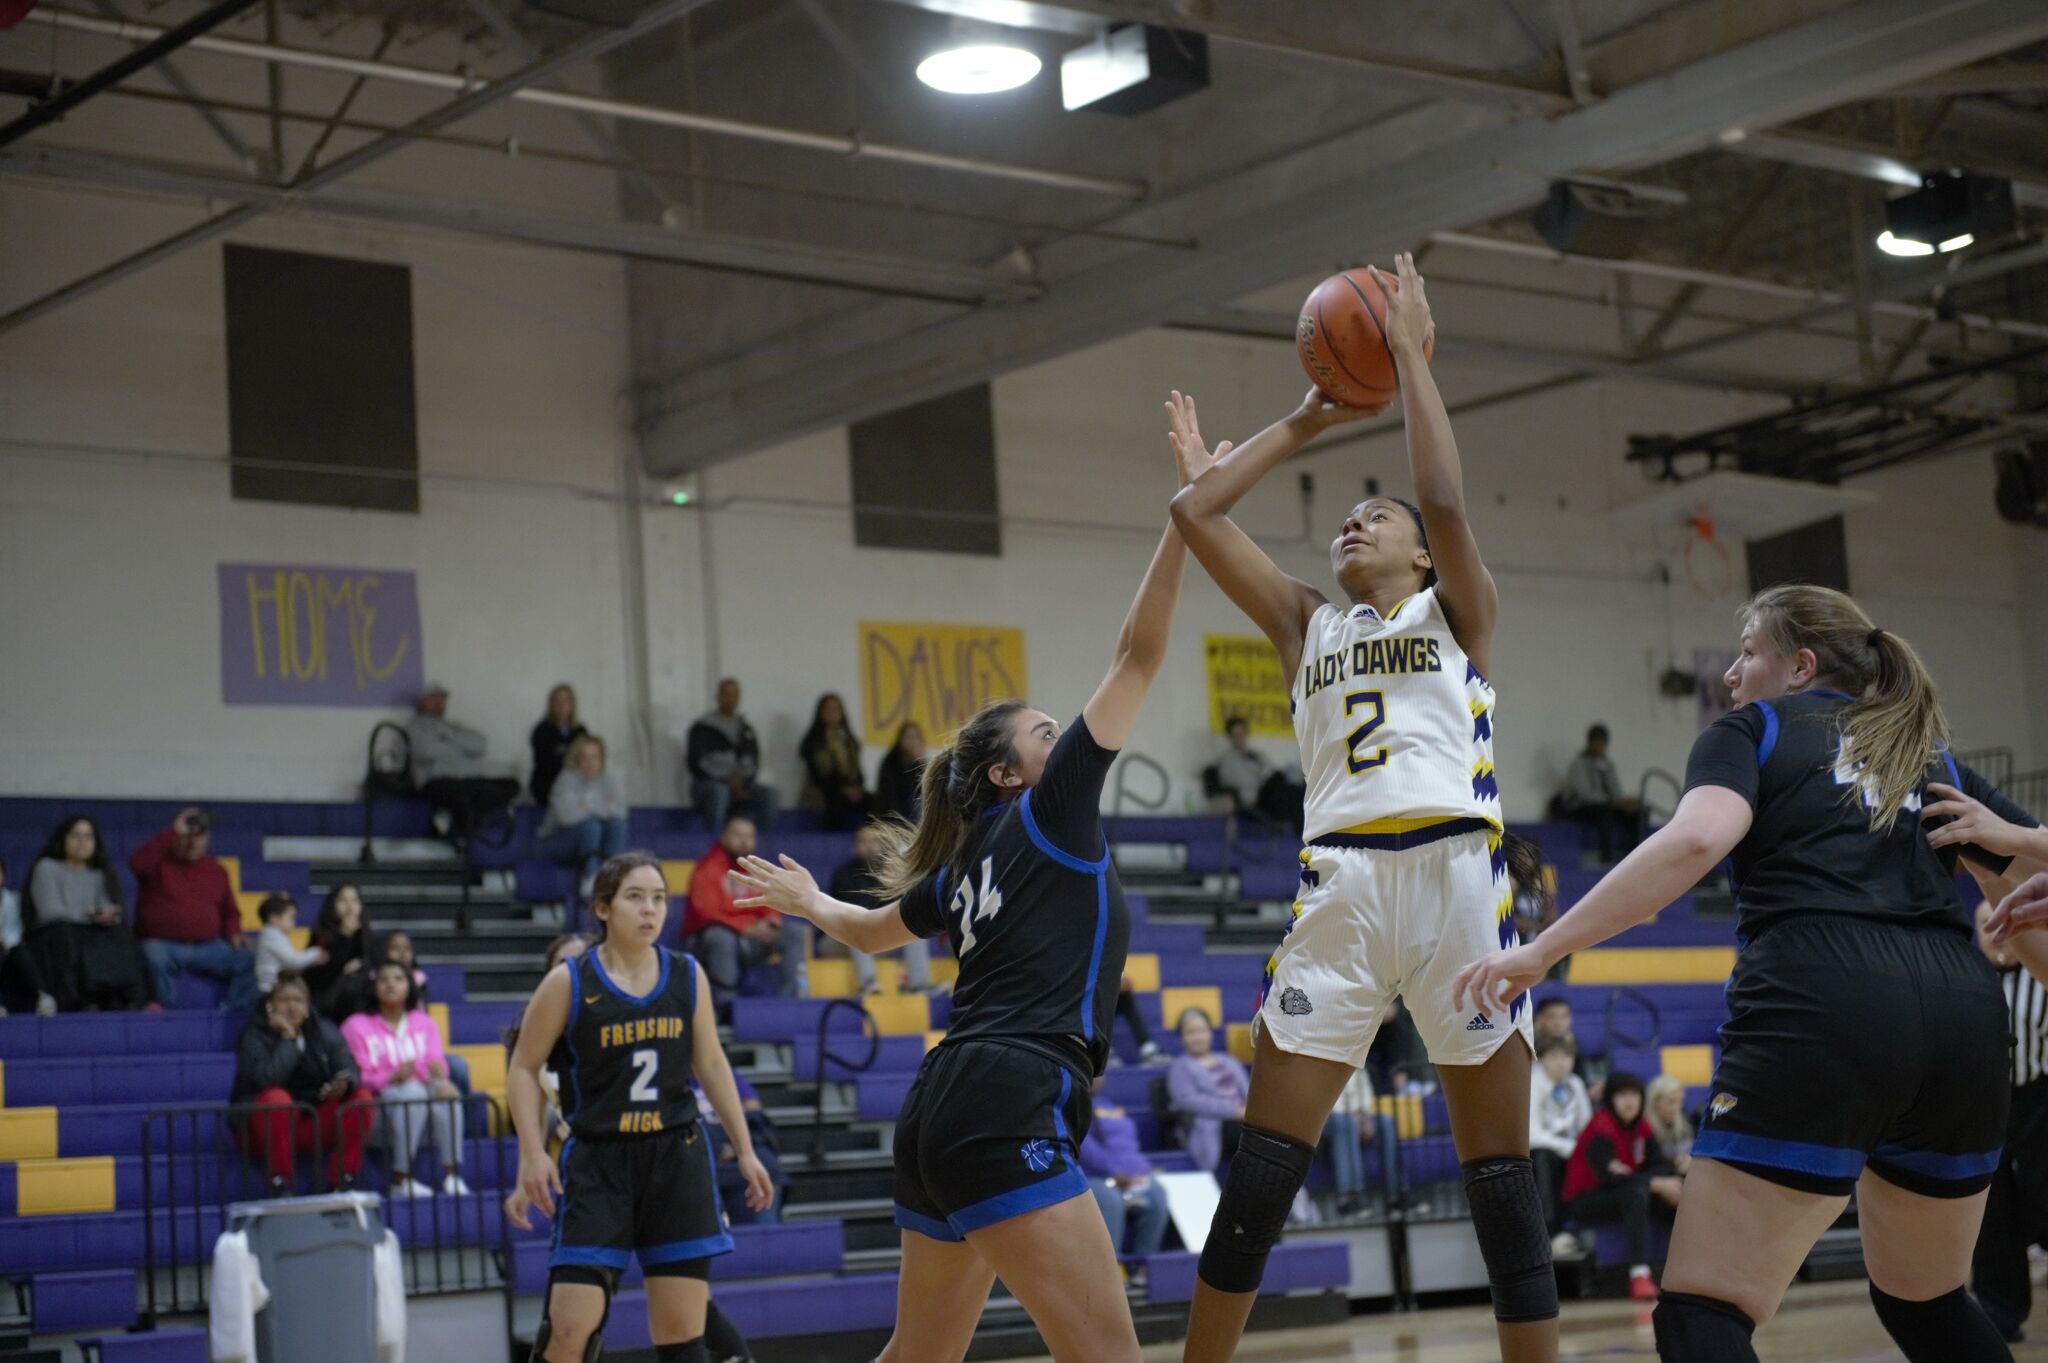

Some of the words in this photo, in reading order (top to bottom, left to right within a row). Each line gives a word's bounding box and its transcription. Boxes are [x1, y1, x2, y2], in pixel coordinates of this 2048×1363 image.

[247, 570, 410, 689] HOME
[869, 631, 1018, 733] DAWGS
[1304, 647, 1350, 700] LADY
[1352, 637, 1443, 677] DAWGS
[1343, 688, 1391, 778] 2
[950, 855, 1003, 958] 24
[600, 1017, 684, 1049] FRENSHIP
[1466, 1023, 1495, 1031] adidas
[629, 1049, 659, 1102] 2
